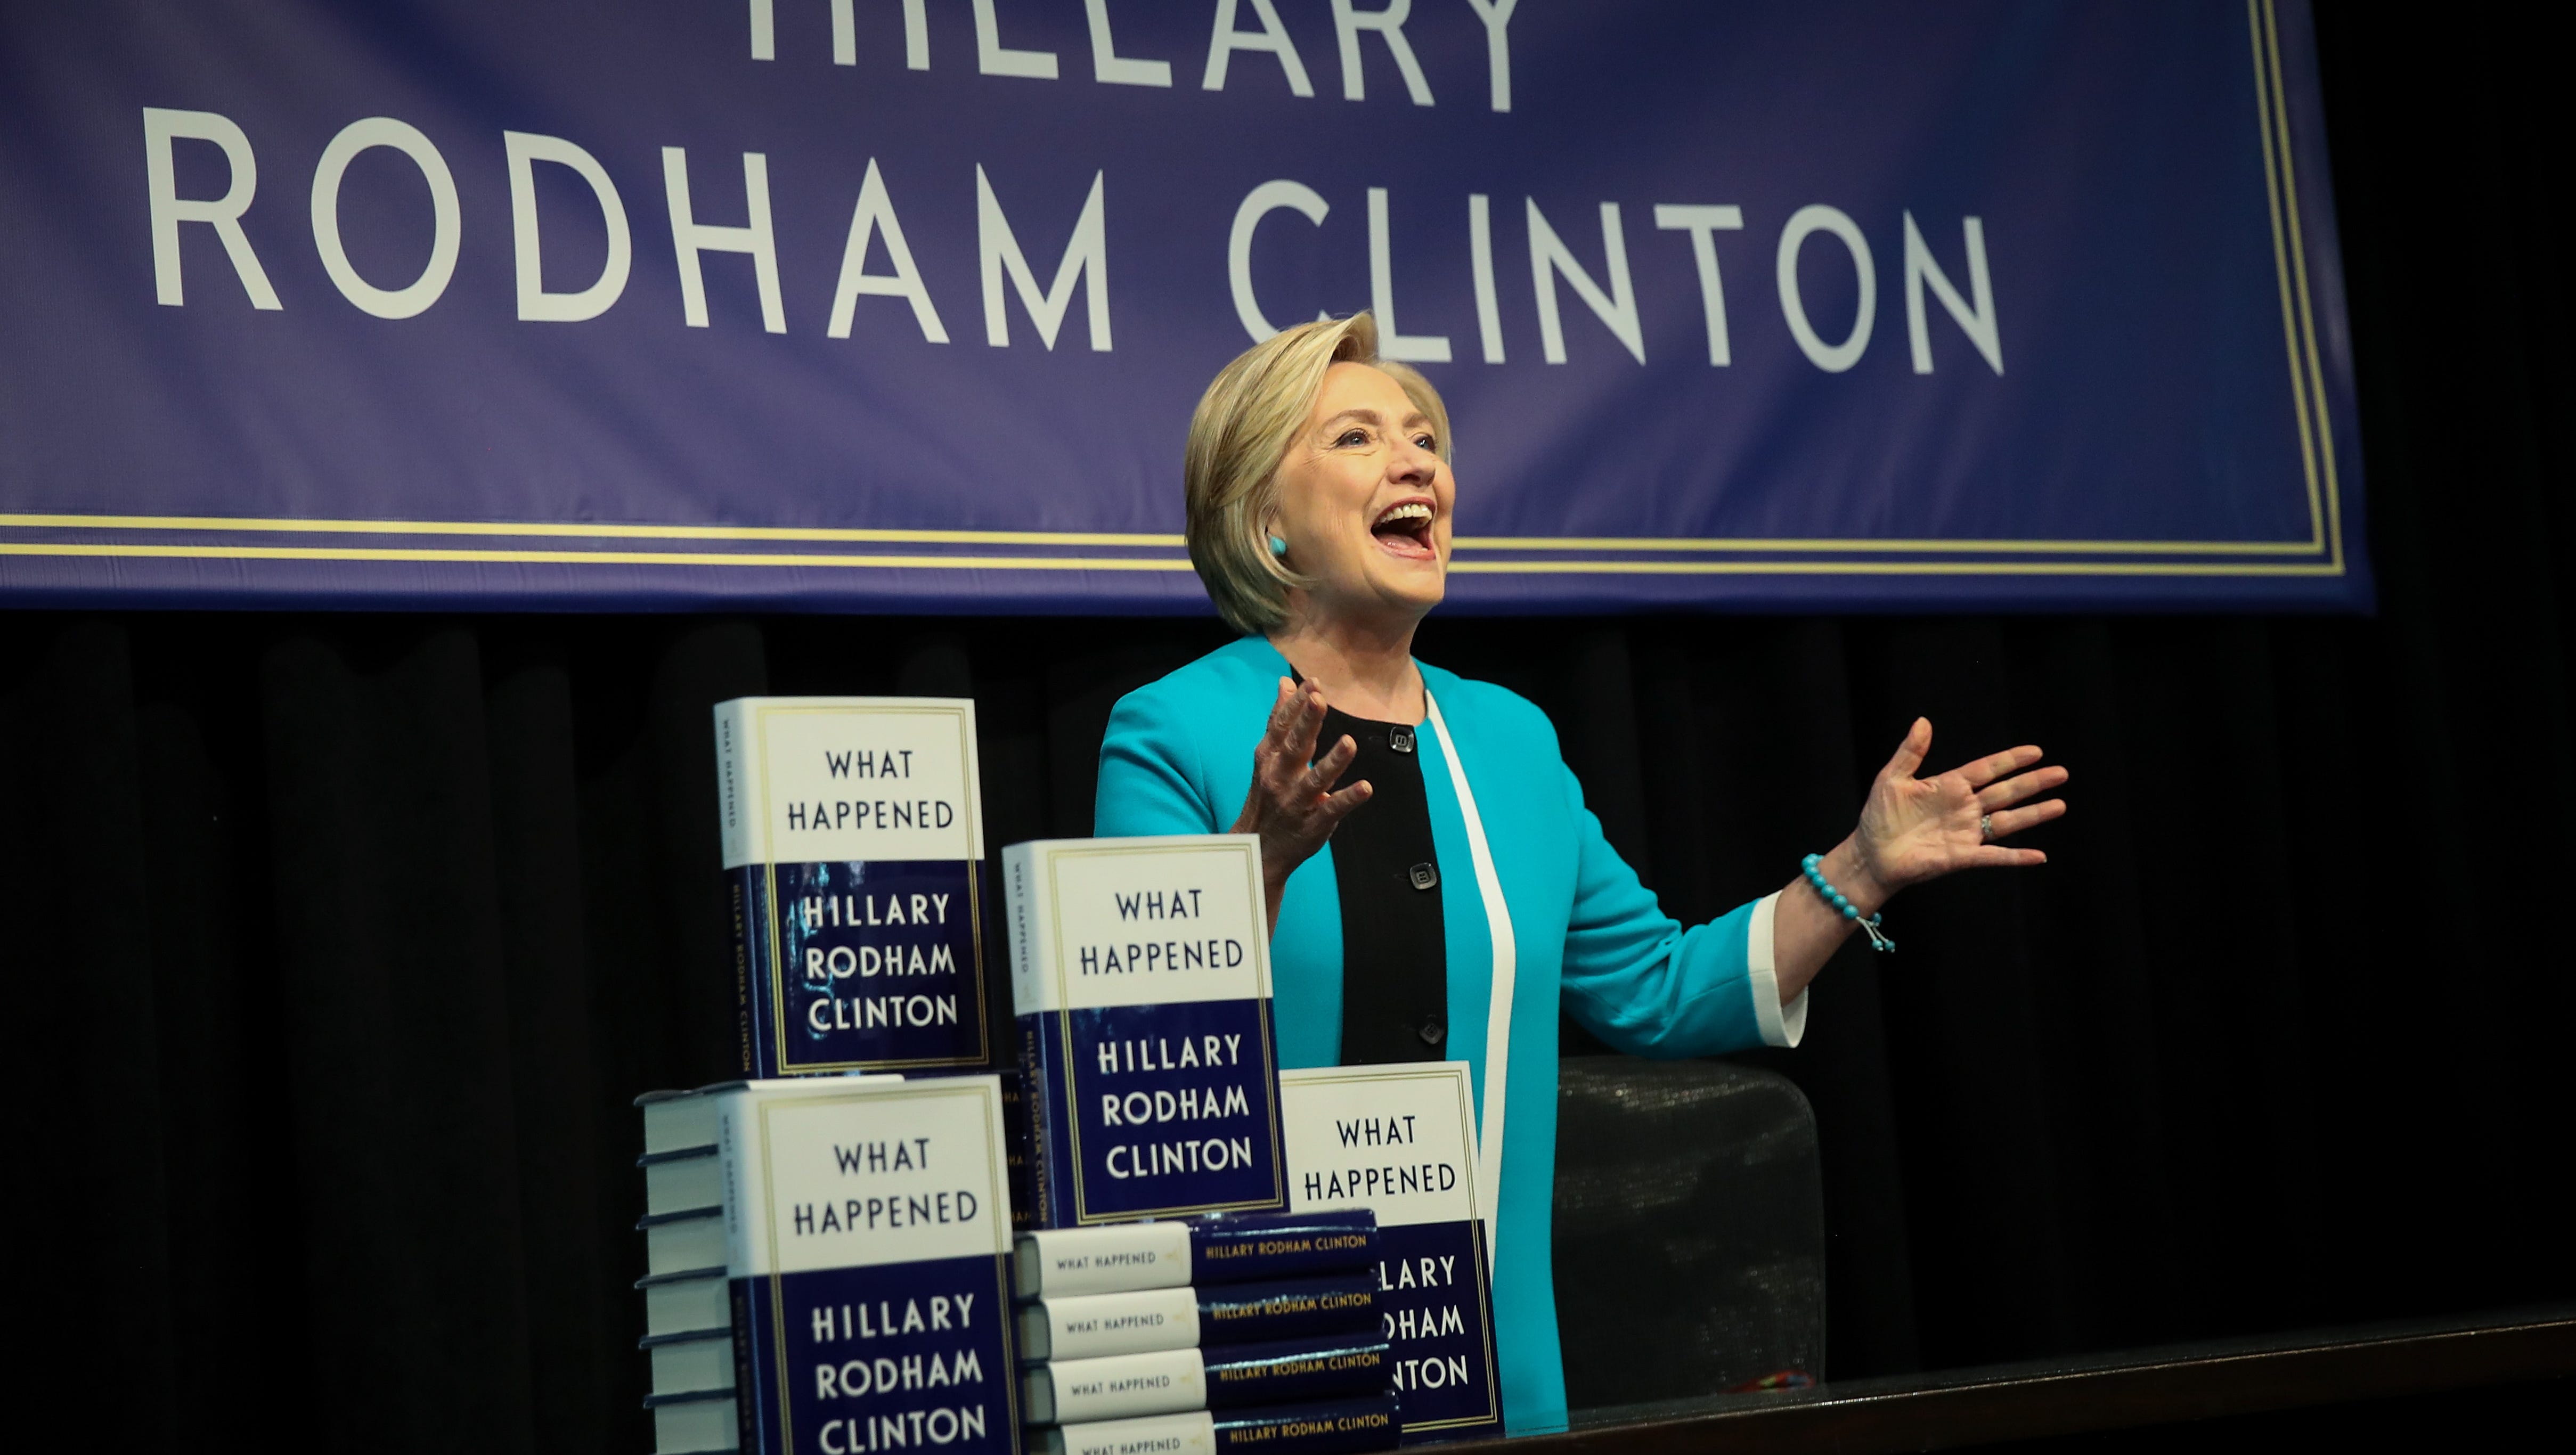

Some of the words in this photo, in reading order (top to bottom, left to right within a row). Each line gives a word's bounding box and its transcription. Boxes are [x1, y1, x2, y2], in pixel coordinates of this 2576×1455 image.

[143, 107, 1112, 352] RODHAM
[1228, 178, 2004, 376] CLINTON
[826, 750, 912, 779] WHAT
[789, 801, 953, 830] HAPPENED
[803, 893, 949, 928] HILLARY
[1115, 889, 1202, 921] WHAT
[806, 943, 956, 979] RODHAM
[1081, 939, 1243, 975] HAPPENED
[808, 995, 957, 1031] CLINTON
[1098, 1034, 1241, 1074] HILLARY
[1103, 1085, 1249, 1126] RODHAM
[1337, 1116, 1415, 1148] WHAT
[834, 1138, 929, 1175] WHAT
[1106, 1137, 1252, 1178] CLINTON
[1305, 1164, 1456, 1200] HAPPENED
[795, 1191, 977, 1236] HAPPENED
[1057, 1256, 1088, 1270] WHAT
[1096, 1252, 1155, 1267] HAPPENED
[1206, 1244, 1253, 1259] HILLARY
[1259, 1239, 1311, 1255] RODHAM
[1315, 1236, 1366, 1250] CLINTON
[1380, 1255, 1455, 1291] LARY
[811, 1293, 974, 1343] HILLARY
[1067, 1320, 1098, 1333] WHAT
[1105, 1313, 1164, 1329] HAPPENED
[1212, 1304, 1259, 1320] HILLARY
[1265, 1299, 1317, 1315] RODHAM
[1321, 1293, 1371, 1310] CLINTON
[1384, 1305, 1465, 1339] HAM
[816, 1348, 983, 1400] RODHAM
[1220, 1366, 1267, 1381] HILLARY
[1273, 1360, 1325, 1376] RODHAM
[1329, 1353, 1380, 1370] CLINTON
[1392, 1355, 1468, 1391] NTON
[1072, 1382, 1103, 1396] WHAT
[1110, 1376, 1170, 1392] HAPPENED
[819, 1404, 985, 1455] CLINTON
[1230, 1427, 1277, 1443] HILLARY
[1282, 1420, 1333, 1437] RODHAM
[1338, 1413, 1388, 1432] CLINTON
[1082, 1445, 1114, 1455] WHAT
[1121, 1438, 1180, 1455] HAPPENED
